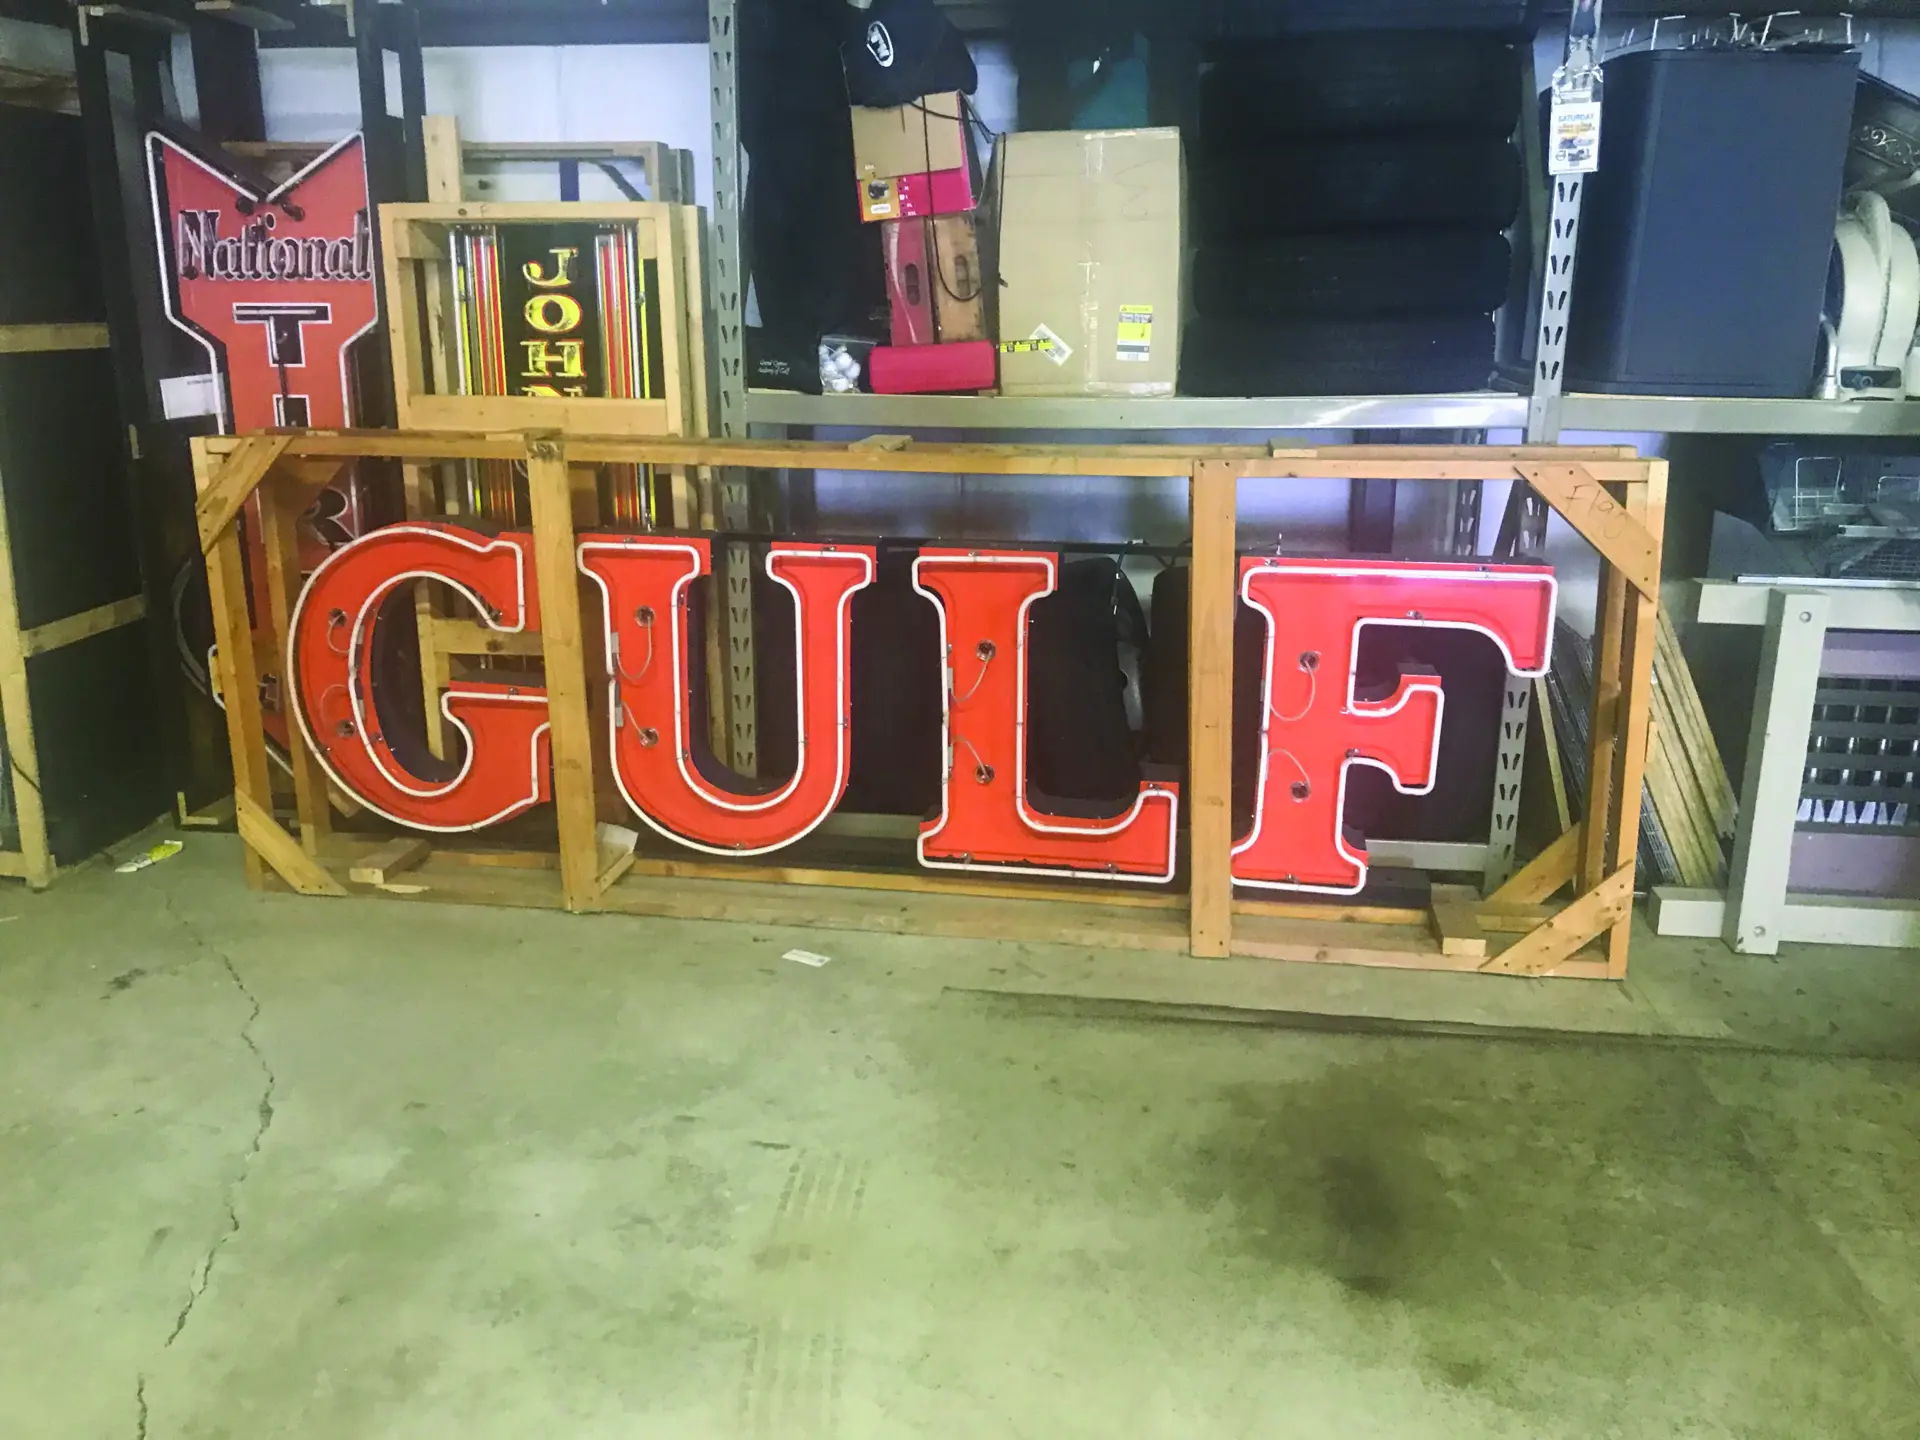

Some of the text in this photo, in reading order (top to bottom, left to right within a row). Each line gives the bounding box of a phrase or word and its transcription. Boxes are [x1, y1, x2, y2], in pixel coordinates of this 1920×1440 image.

[1558, 114, 1594, 122] SATURDAY
[178, 209, 373, 281] National
[520, 248, 588, 397] JOH
[286, 520, 1560, 897] GULF
